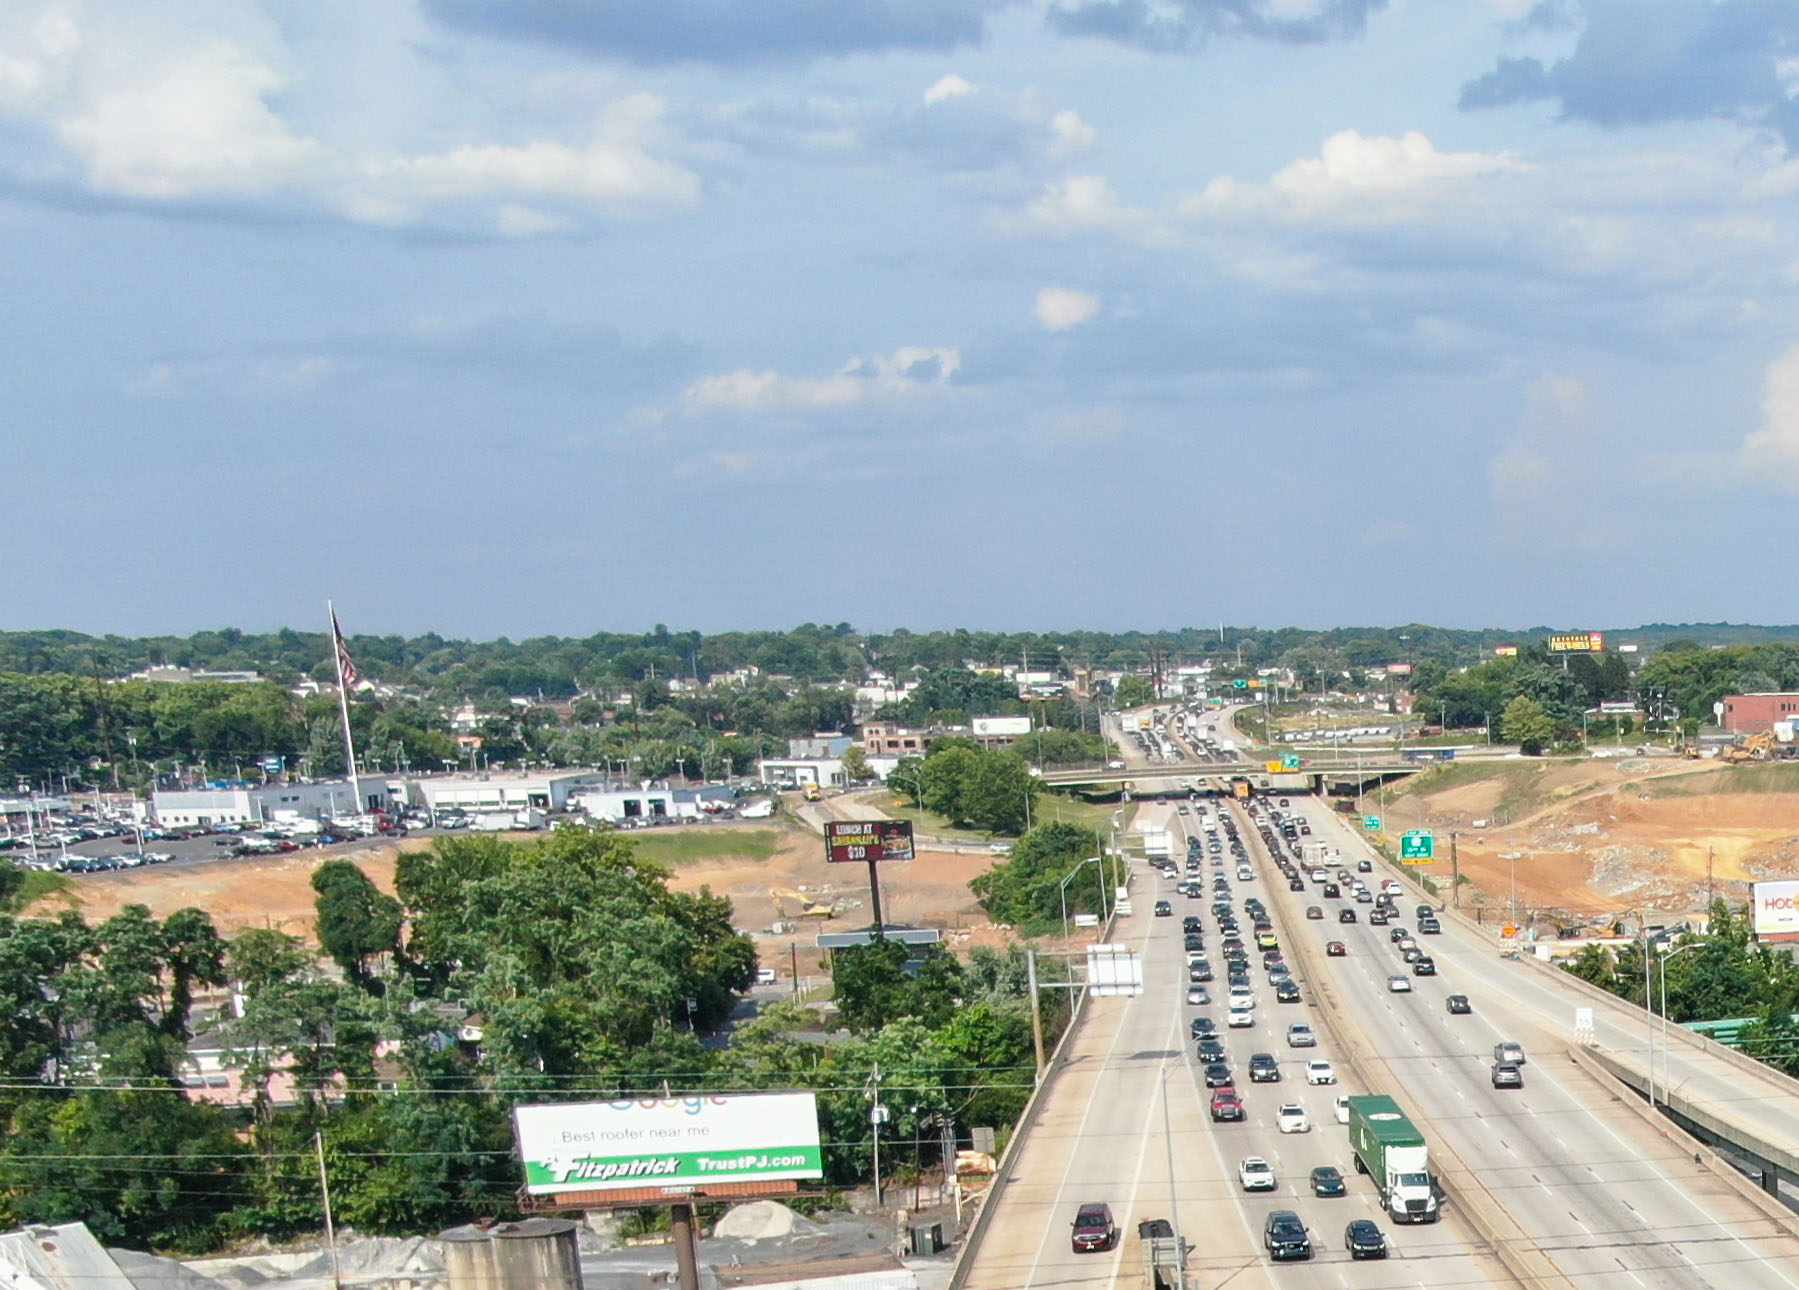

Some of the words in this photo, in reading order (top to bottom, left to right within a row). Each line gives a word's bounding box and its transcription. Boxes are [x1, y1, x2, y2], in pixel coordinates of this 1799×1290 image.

[864, 824, 873, 834] AT
[562, 1130, 595, 1143] Best
[601, 1128, 643, 1141] roofer
[649, 1128, 682, 1138] near
[687, 1126, 710, 1136] me
[697, 1154, 806, 1171] TrustPJ.com
